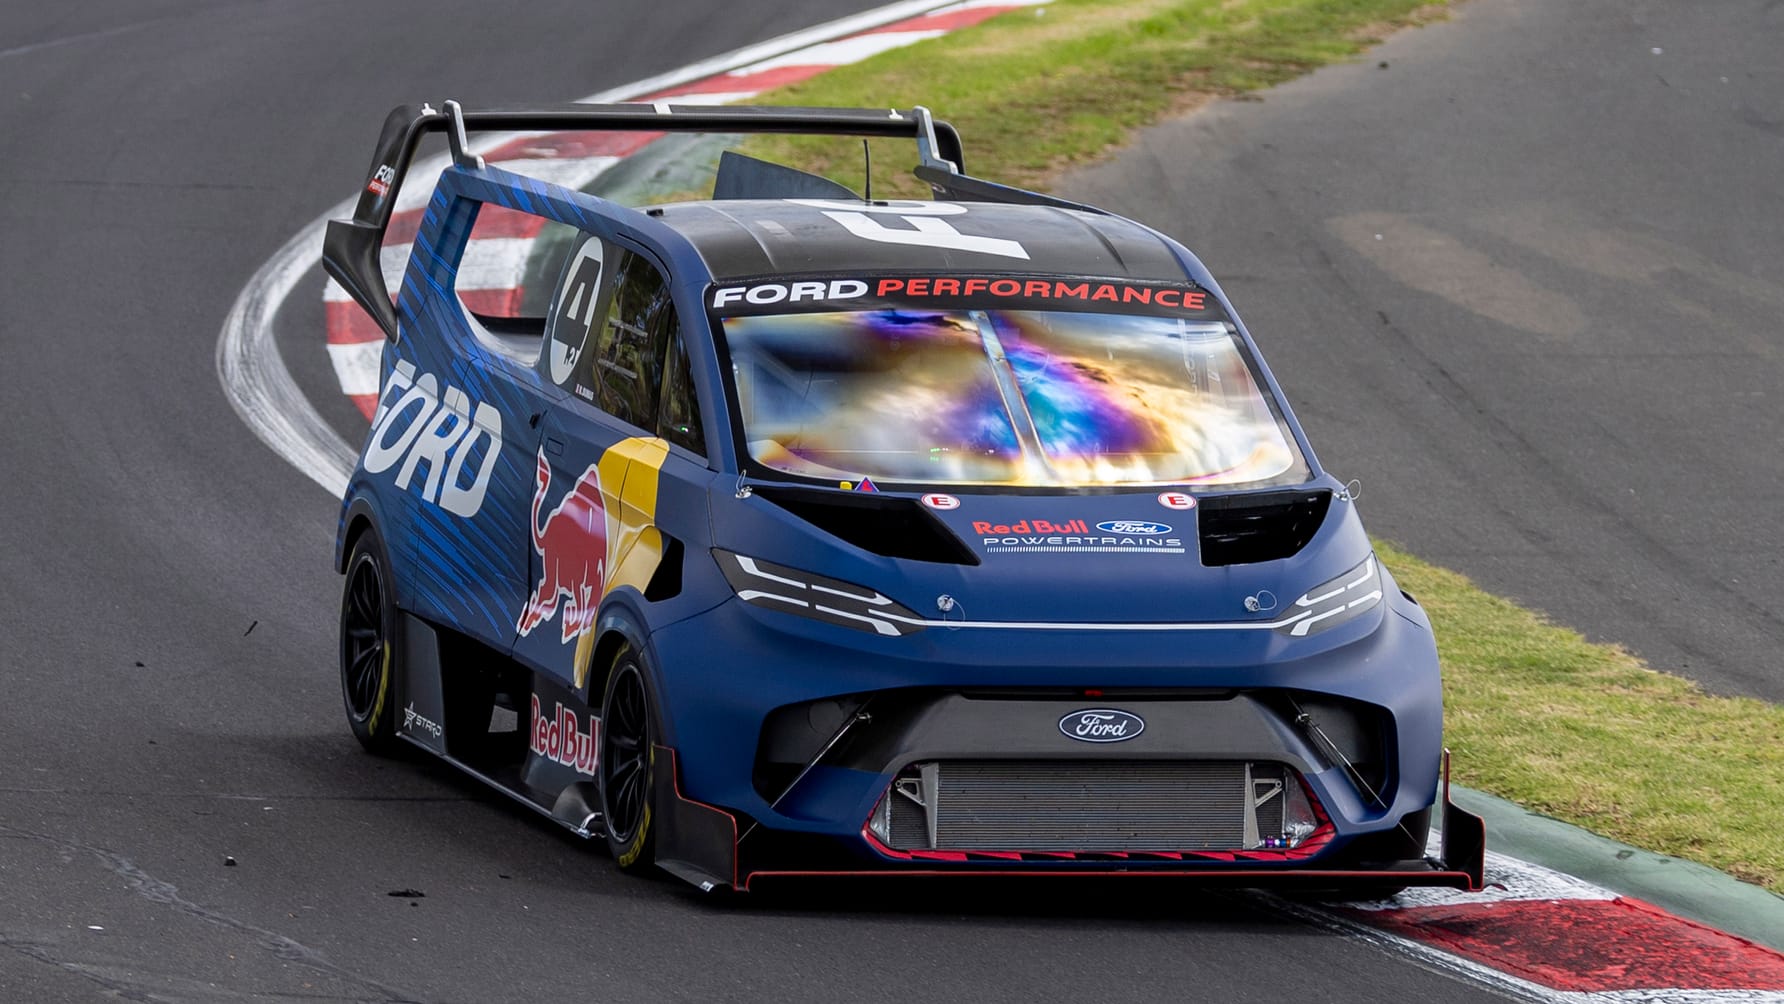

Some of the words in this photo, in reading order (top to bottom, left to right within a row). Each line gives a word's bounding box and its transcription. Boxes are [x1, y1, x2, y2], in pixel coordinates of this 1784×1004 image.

[713, 279, 869, 309] FORD
[877, 278, 1206, 309] PERFORMANCE
[364, 358, 502, 518] FORD
[972, 520, 1032, 536] Red
[1032, 519, 1089, 535] Bull
[1111, 520, 1159, 535] Ford
[983, 536, 1182, 547] POWERTRAINS
[530, 692, 562, 763] Red
[1076, 713, 1128, 736] Ford
